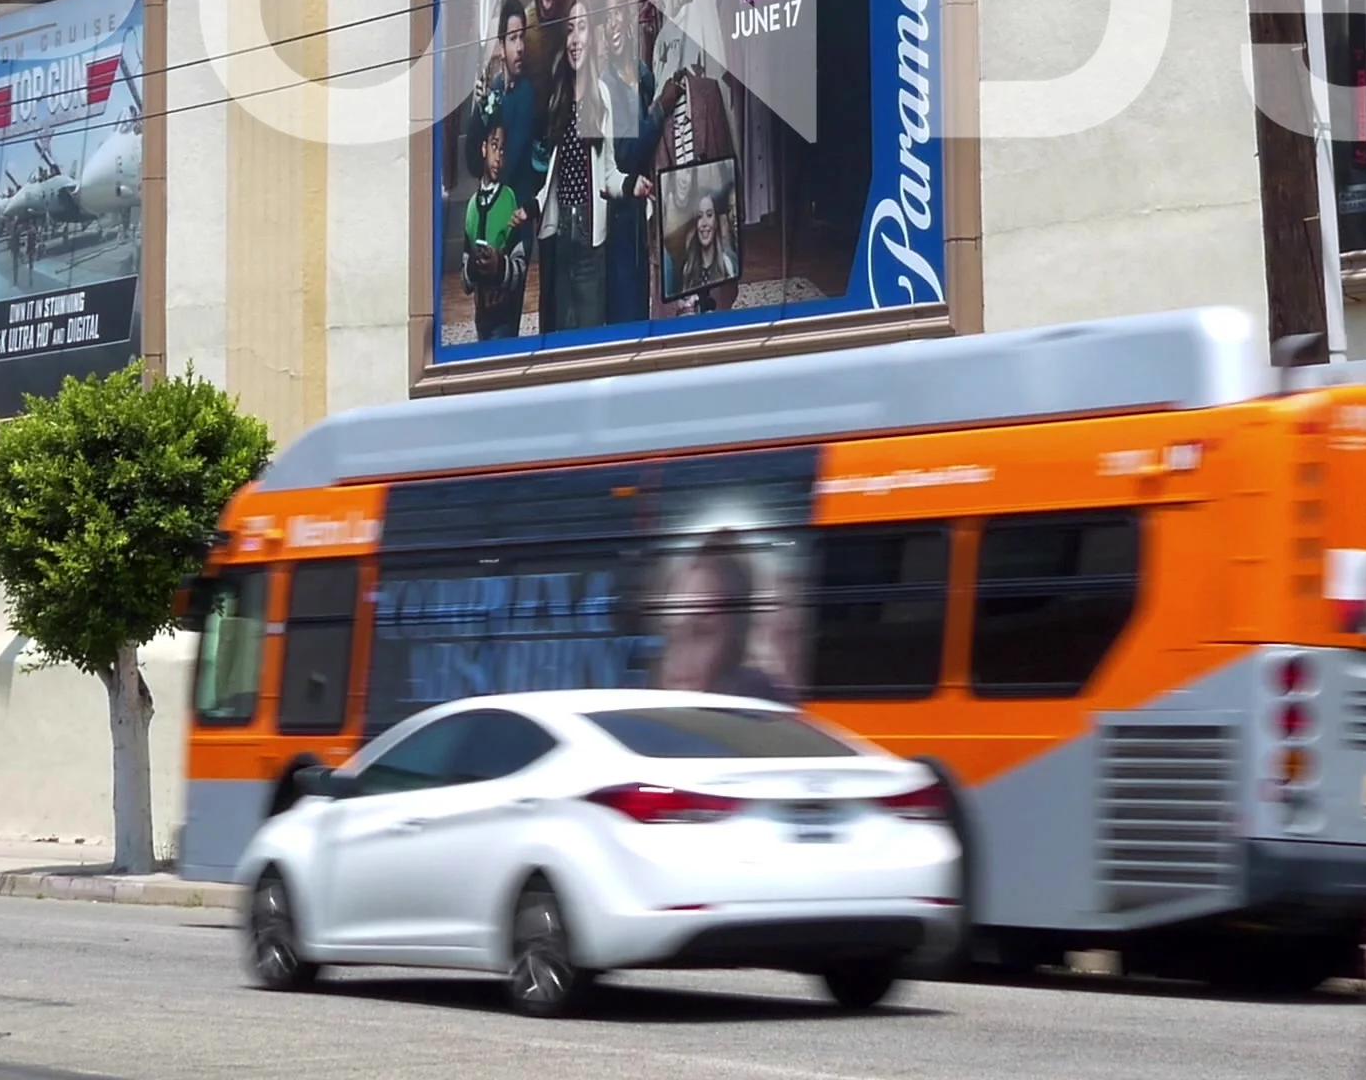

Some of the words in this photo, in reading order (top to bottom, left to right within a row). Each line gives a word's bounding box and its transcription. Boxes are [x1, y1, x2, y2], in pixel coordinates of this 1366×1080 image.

[40, 14, 116, 52] CRUISE
[731, 3, 781, 40] JUNE
[783, 0, 803, 28] 17
[11, 66, 45, 125] TOP
[46, 54, 88, 115] GUN
[9, 302, 26, 324] OWN
[26, 300, 35, 321] IT
[35, 299, 44, 319] IN
[43, 291, 86, 318] STUNNING
[8, 323, 34, 353] ULTRA
[52, 327, 66, 346] AND
[66, 313, 100, 343] DIGITAL
